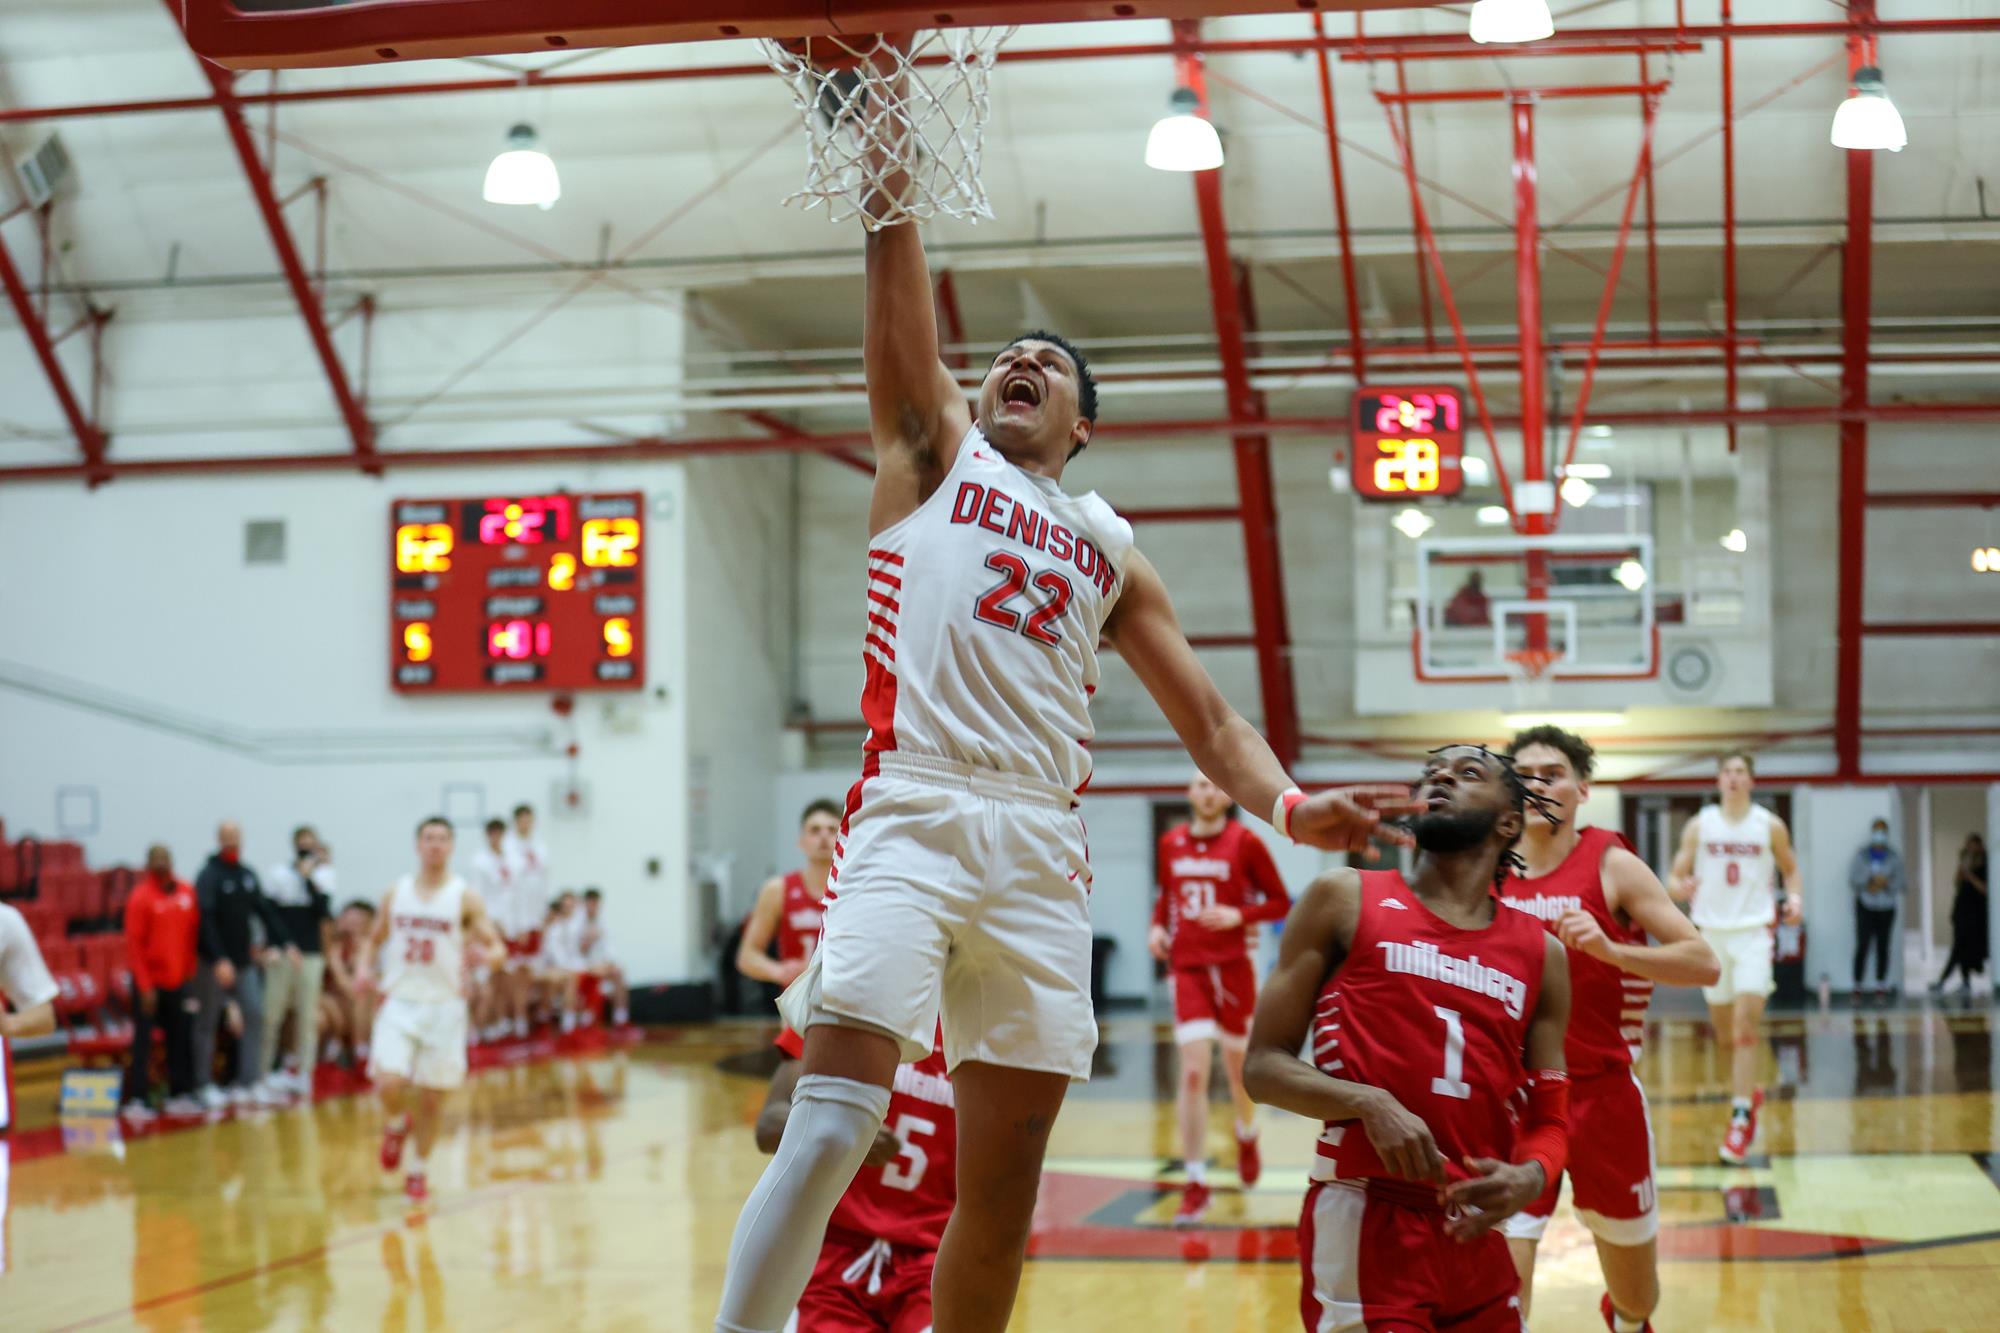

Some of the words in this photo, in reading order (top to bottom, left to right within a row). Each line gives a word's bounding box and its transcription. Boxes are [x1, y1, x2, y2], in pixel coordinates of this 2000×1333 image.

[1376, 393, 1459, 433] 2:27
[1374, 438, 1440, 492] 28
[950, 481, 1116, 598] DENISON
[548, 552, 577, 590] 2
[973, 549, 1074, 650] 22
[404, 622, 433, 661] 5
[604, 617, 633, 657] 5
[1431, 1005, 1471, 1100] 1
[880, 1112, 936, 1192] 5
